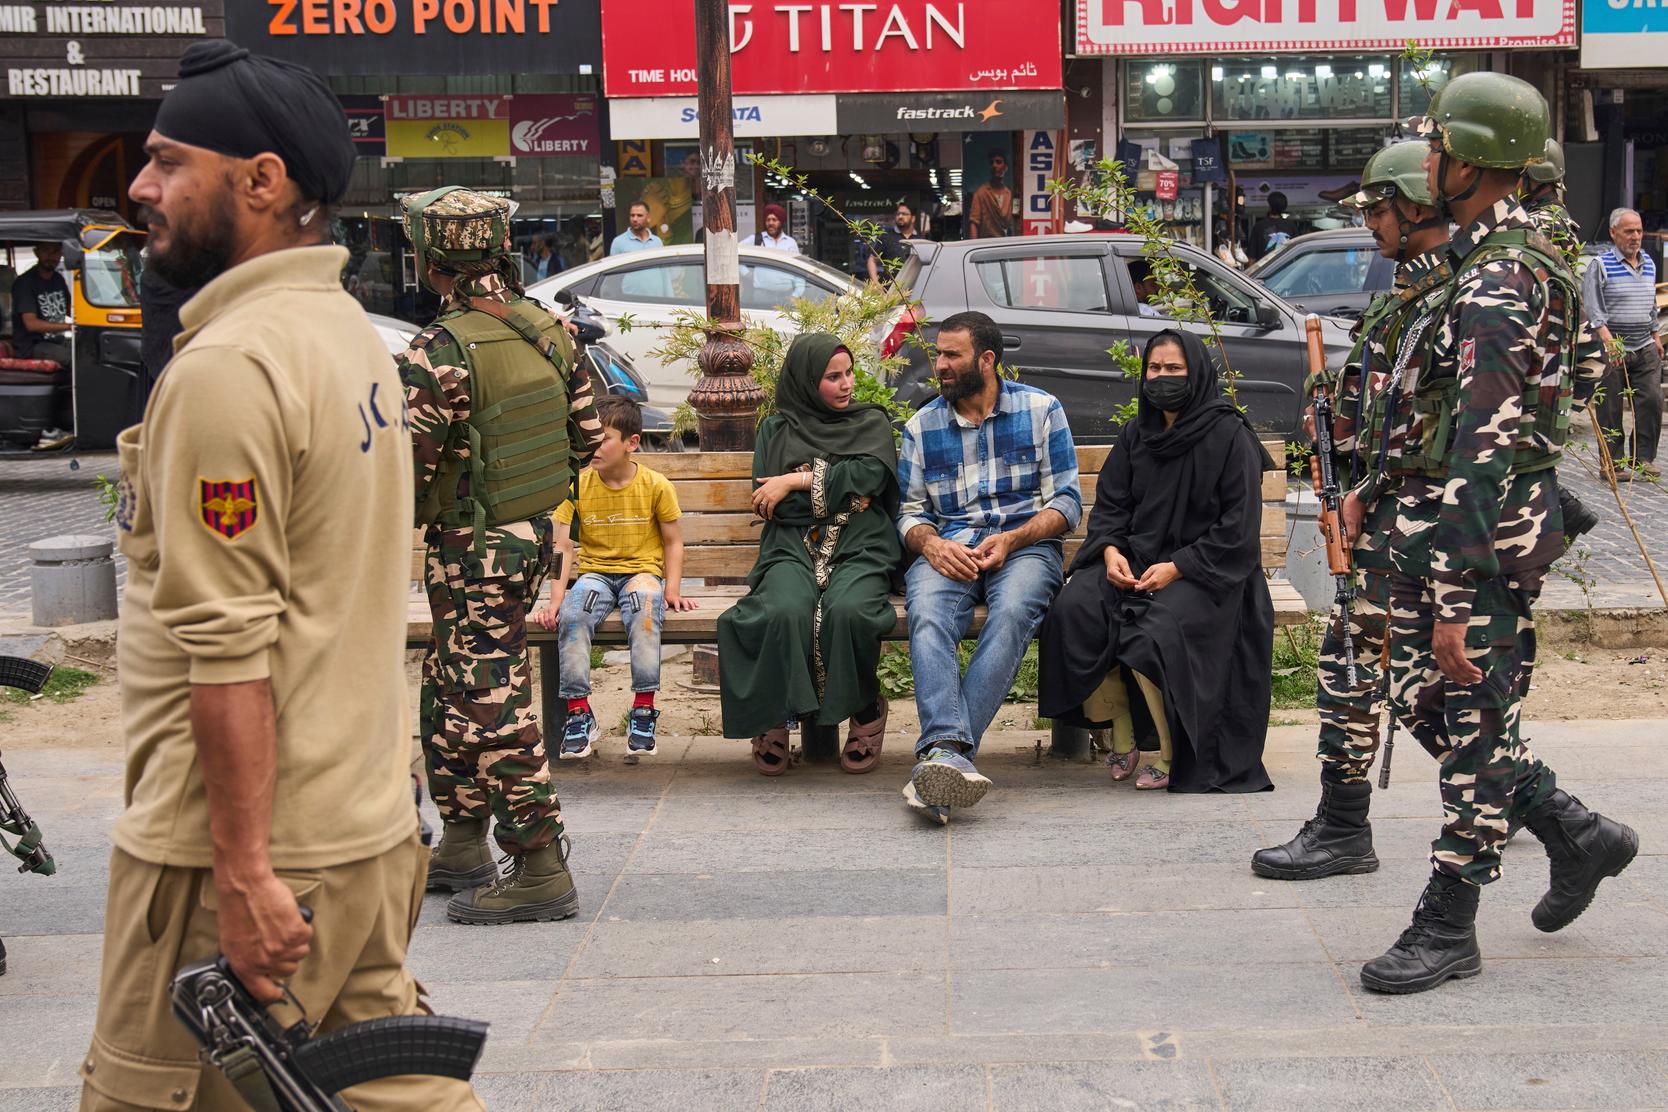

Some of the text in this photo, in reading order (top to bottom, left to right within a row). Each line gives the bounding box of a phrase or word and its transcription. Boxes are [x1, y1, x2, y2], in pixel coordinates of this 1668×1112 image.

[46, 6, 206, 34] INTERNATIONAL
[269, 0, 557, 35] ZERO POINT
[774, 2, 965, 52] TITAN
[1499, 37, 1557, 47] Promise
[66, 40, 86, 65] &
[8, 68, 142, 96] RESTAURANT
[628, 69, 698, 83] TIME HOU
[393, 99, 499, 119] LIBERTY
[681, 106, 762, 123] STA
[896, 105, 975, 119] fastrack
[534, 140, 589, 152] LIBERTY
